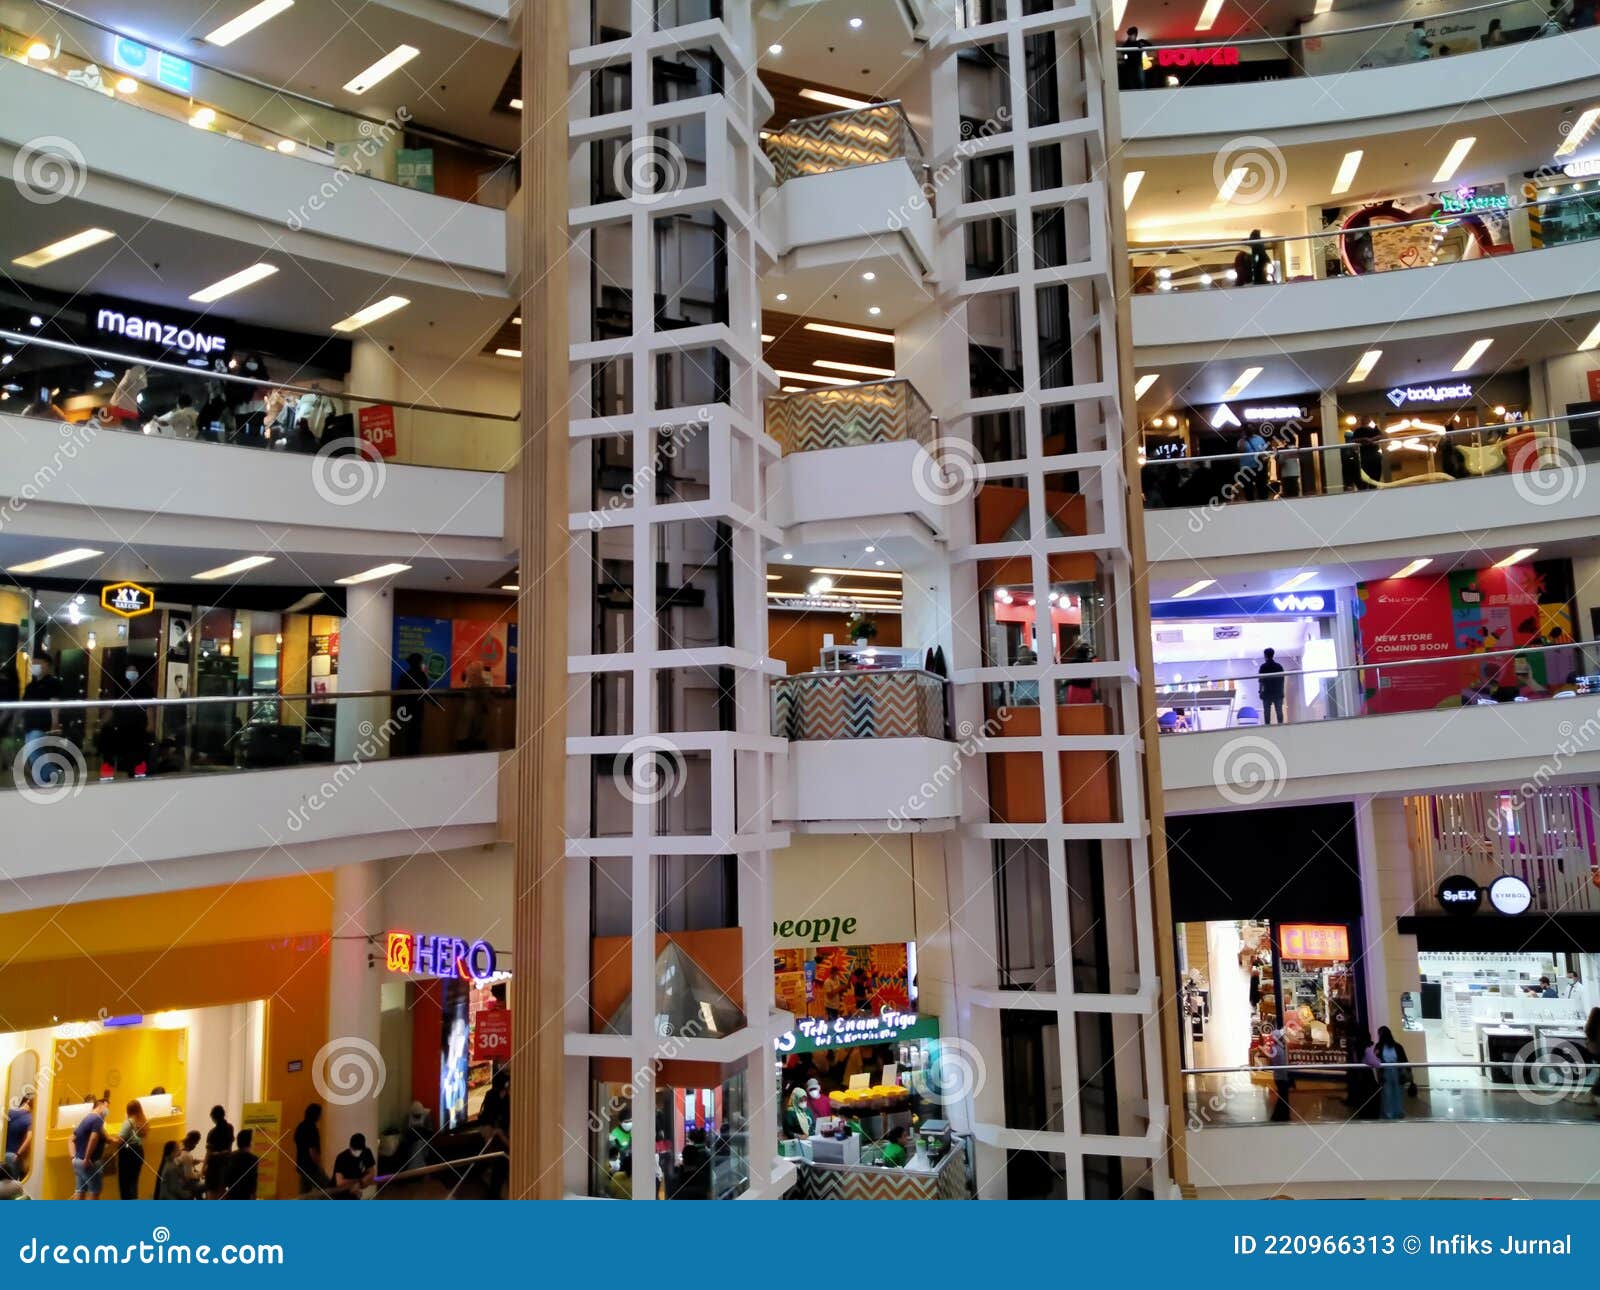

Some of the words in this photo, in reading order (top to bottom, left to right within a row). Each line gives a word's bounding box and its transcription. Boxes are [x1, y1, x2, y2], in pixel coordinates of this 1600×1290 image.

[1406, 383, 1473, 402] bodypack
[116, 588, 140, 602] XY
[1272, 593, 1325, 611] vivo
[1375, 634, 1398, 643] NEW
[1400, 632, 1433, 642] STORE
[1375, 644, 1418, 653] COMING
[1420, 642, 1449, 652] SOON
[1495, 892, 1526, 900] SYMBOL
[773, 916, 857, 943] eople
[414, 934, 497, 980] HERO
[833, 1017, 879, 1033] Enam
[880, 1006, 917, 1030] Tiga
[478, 1033, 508, 1049] 30%
